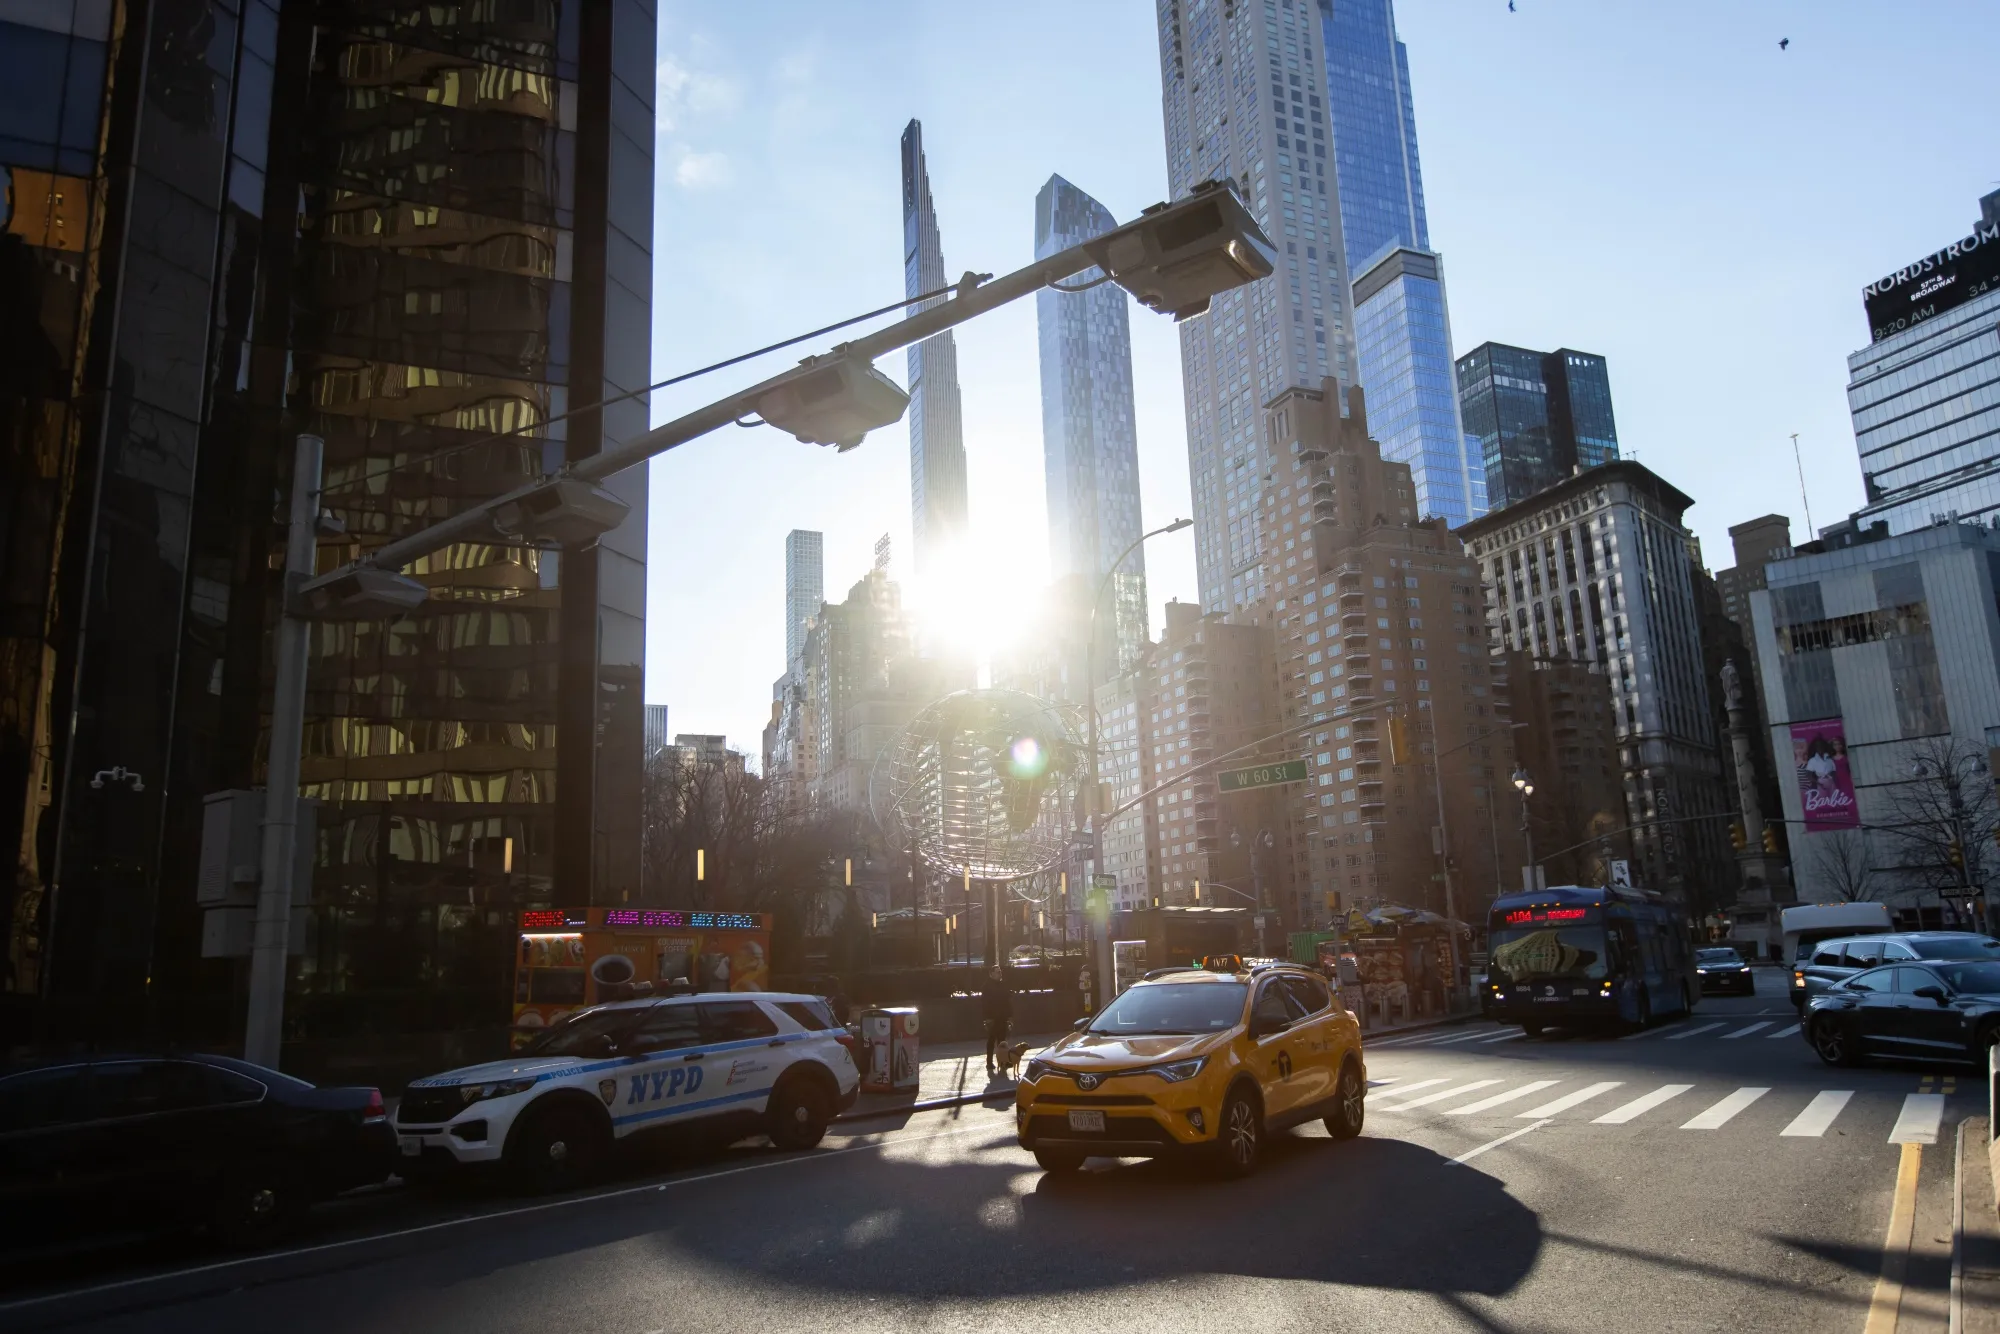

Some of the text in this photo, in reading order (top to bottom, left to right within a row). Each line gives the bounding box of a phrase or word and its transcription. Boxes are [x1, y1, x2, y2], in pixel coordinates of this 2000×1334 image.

[1863, 221, 2000, 301] NORDSTROM
[1910, 274, 1957, 301] BROADWAY
[1873, 303, 1935, 340] 9:20 AM
[1236, 765, 1288, 786] W 60 St
[1804, 788, 1853, 811] Barbie
[550, 1066, 585, 1079] POLICE
[628, 1065, 704, 1105] NYPD
